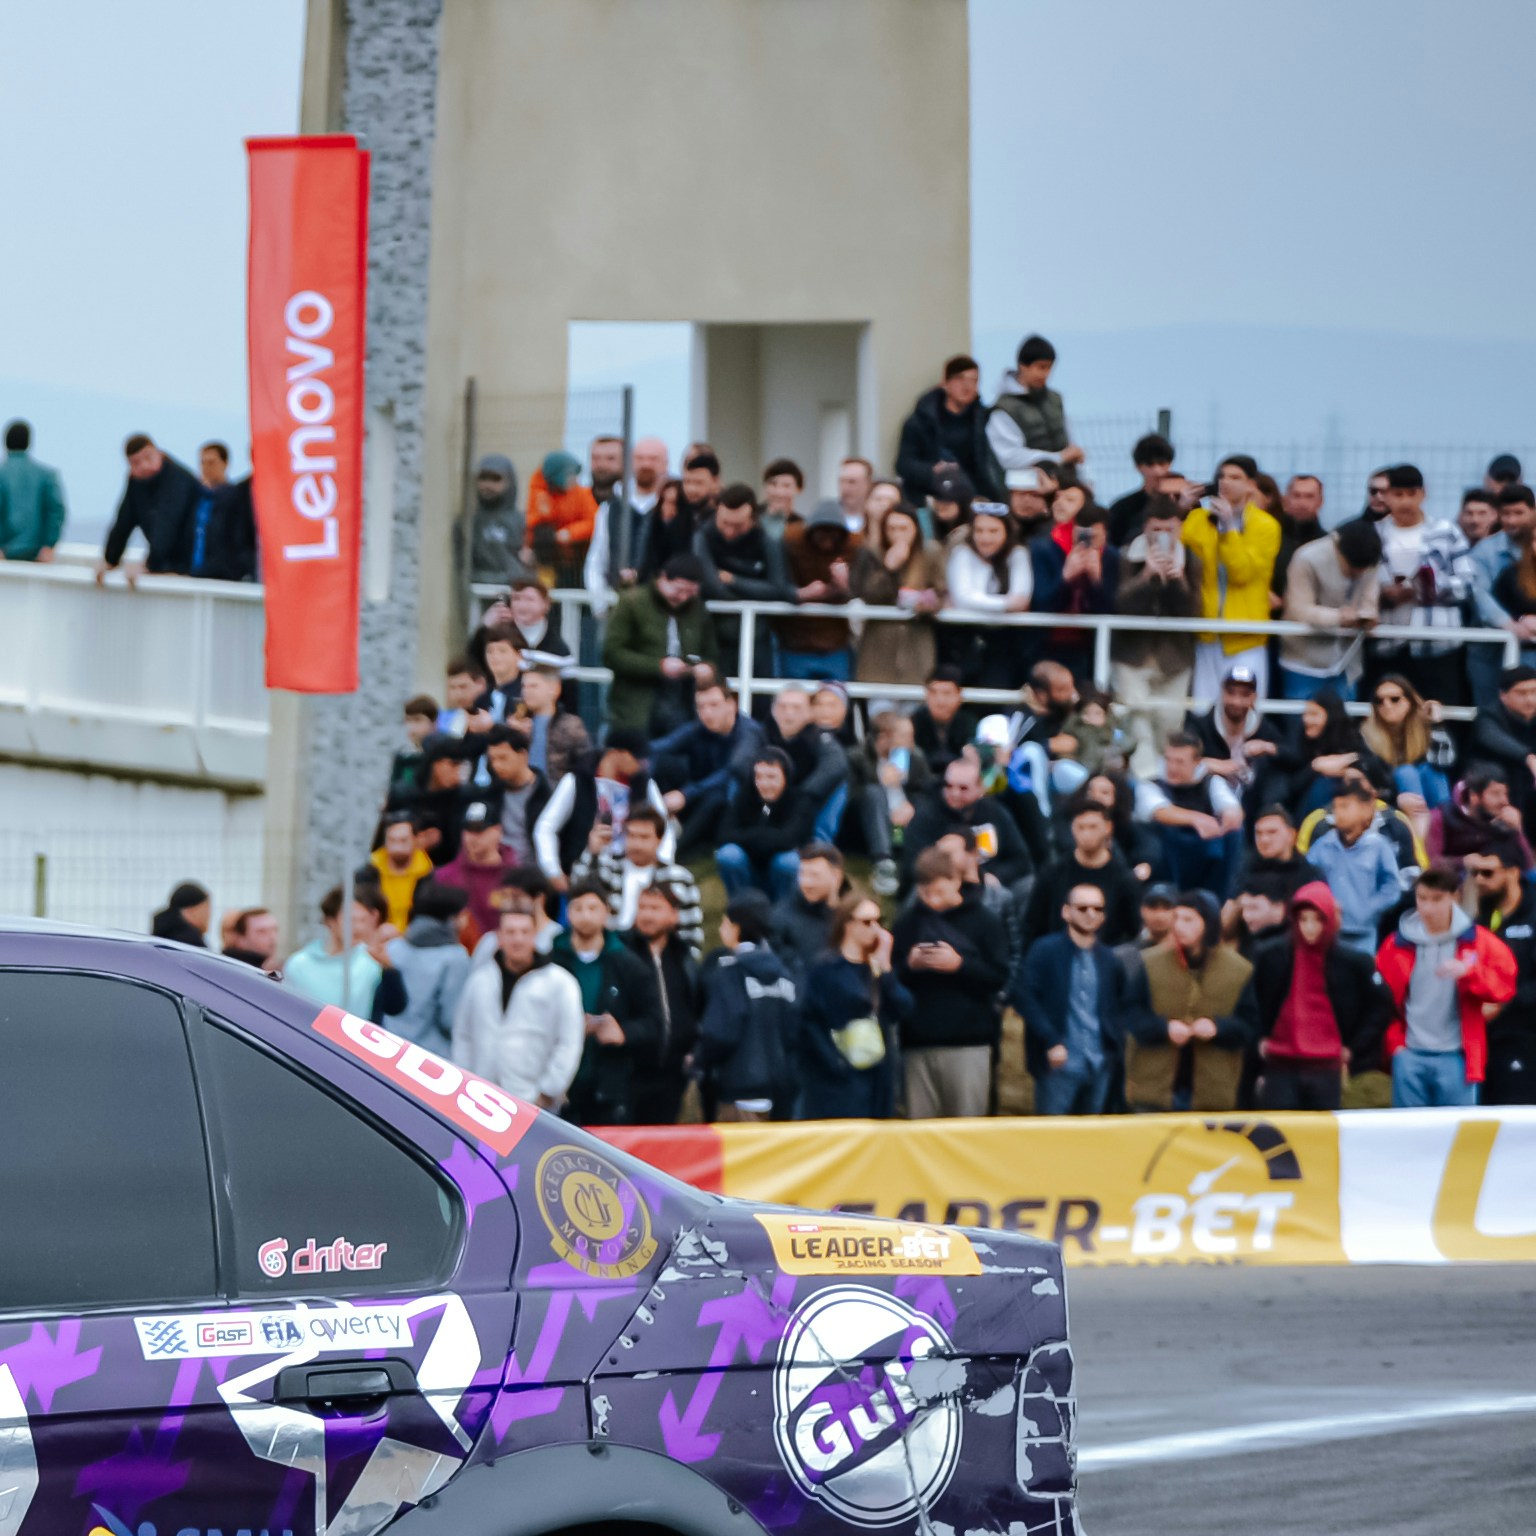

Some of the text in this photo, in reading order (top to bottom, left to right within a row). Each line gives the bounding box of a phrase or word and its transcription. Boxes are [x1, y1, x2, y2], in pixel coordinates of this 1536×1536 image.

[283, 290, 339, 561] Lenovo
[340, 1013, 518, 1133] GDS
[291, 1237, 388, 1274] drifter
[790, 1235, 951, 1260] LEADER-BET
[836, 1259, 943, 1269] RACING SEASON
[264, 1321, 305, 1343] FIA
[309, 1313, 402, 1342] qwerty
